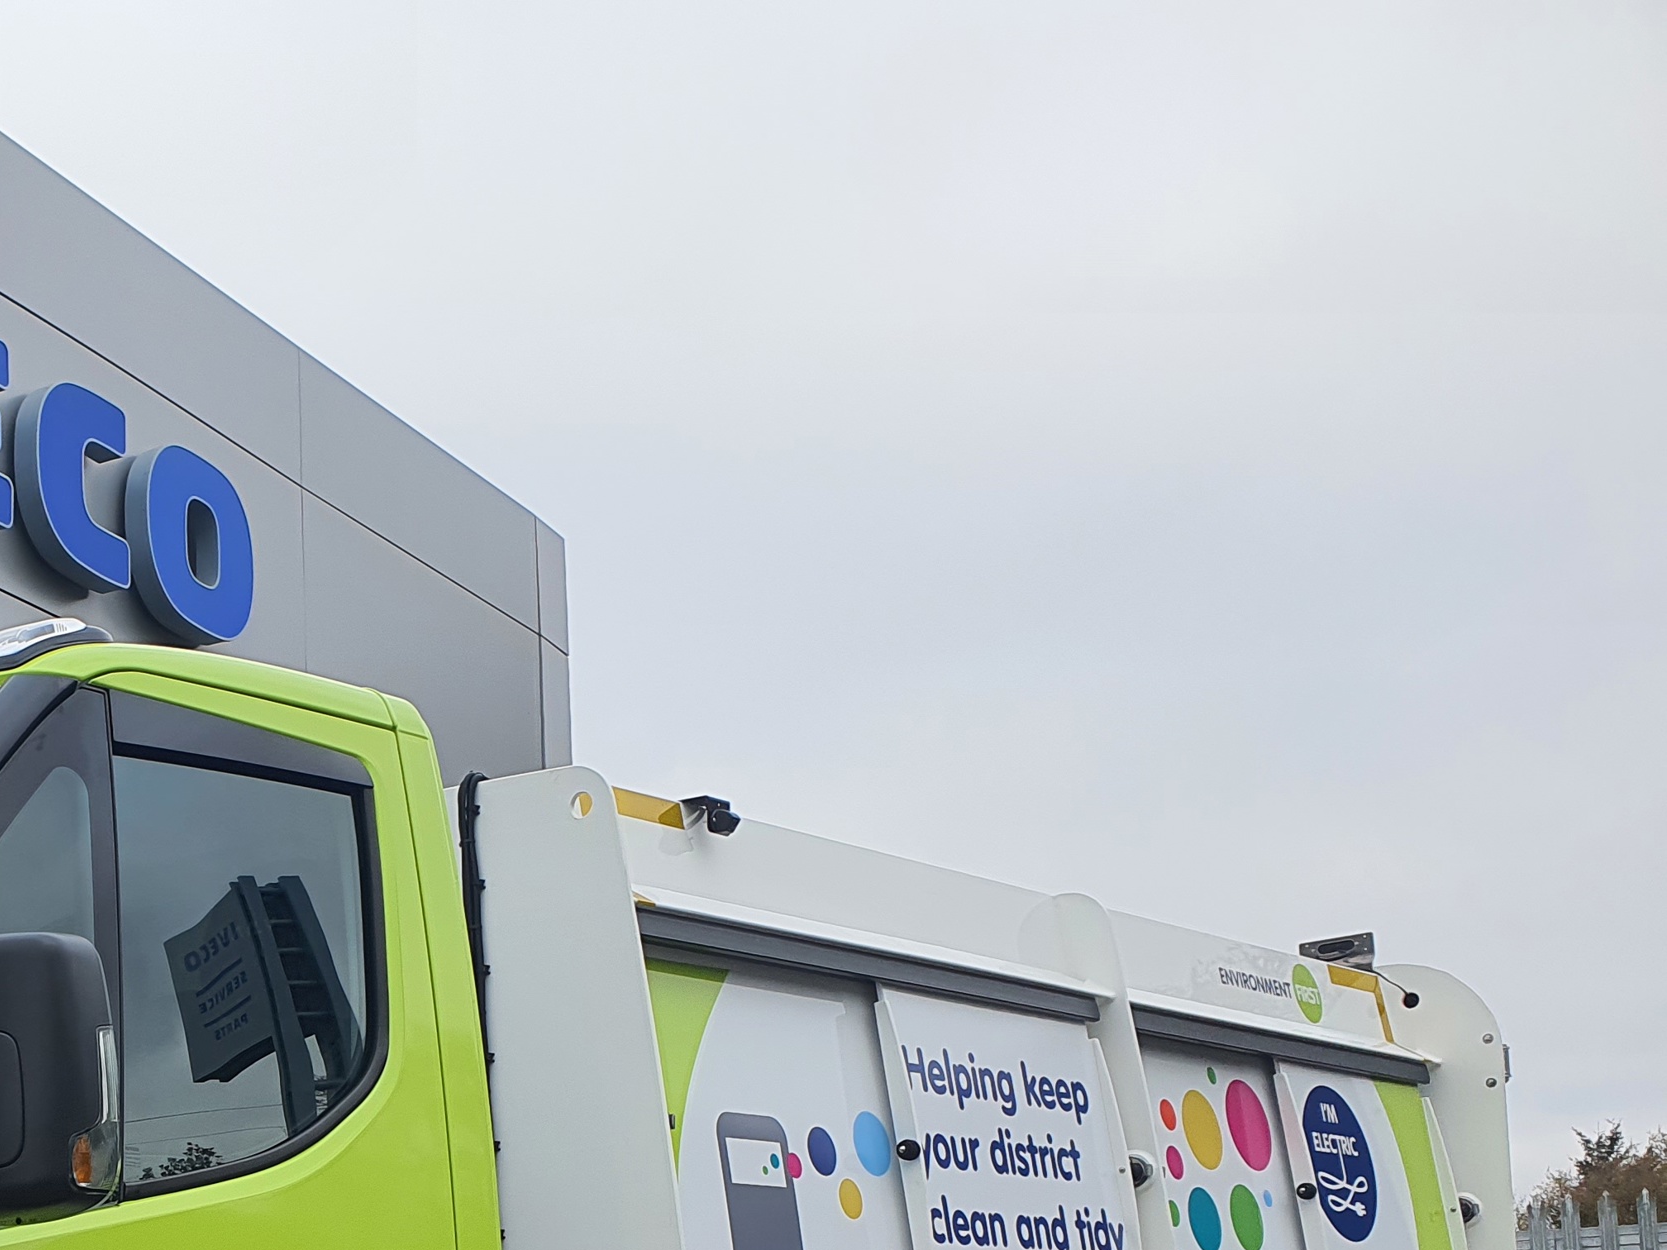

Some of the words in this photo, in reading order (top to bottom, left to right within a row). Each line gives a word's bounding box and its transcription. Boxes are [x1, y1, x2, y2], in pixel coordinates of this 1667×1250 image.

[1218, 967, 1292, 999] ENVIRONMENT
[1294, 984, 1321, 1005] FIRST
[901, 1044, 1017, 1117] Helping
[1020, 1060, 1089, 1125] keep
[1319, 1102, 1339, 1124] I'M
[922, 1131, 980, 1181] your
[990, 1132, 1082, 1182] district
[1311, 1131, 1359, 1157] ELECTRIC
[931, 1194, 1008, 1248] clean
